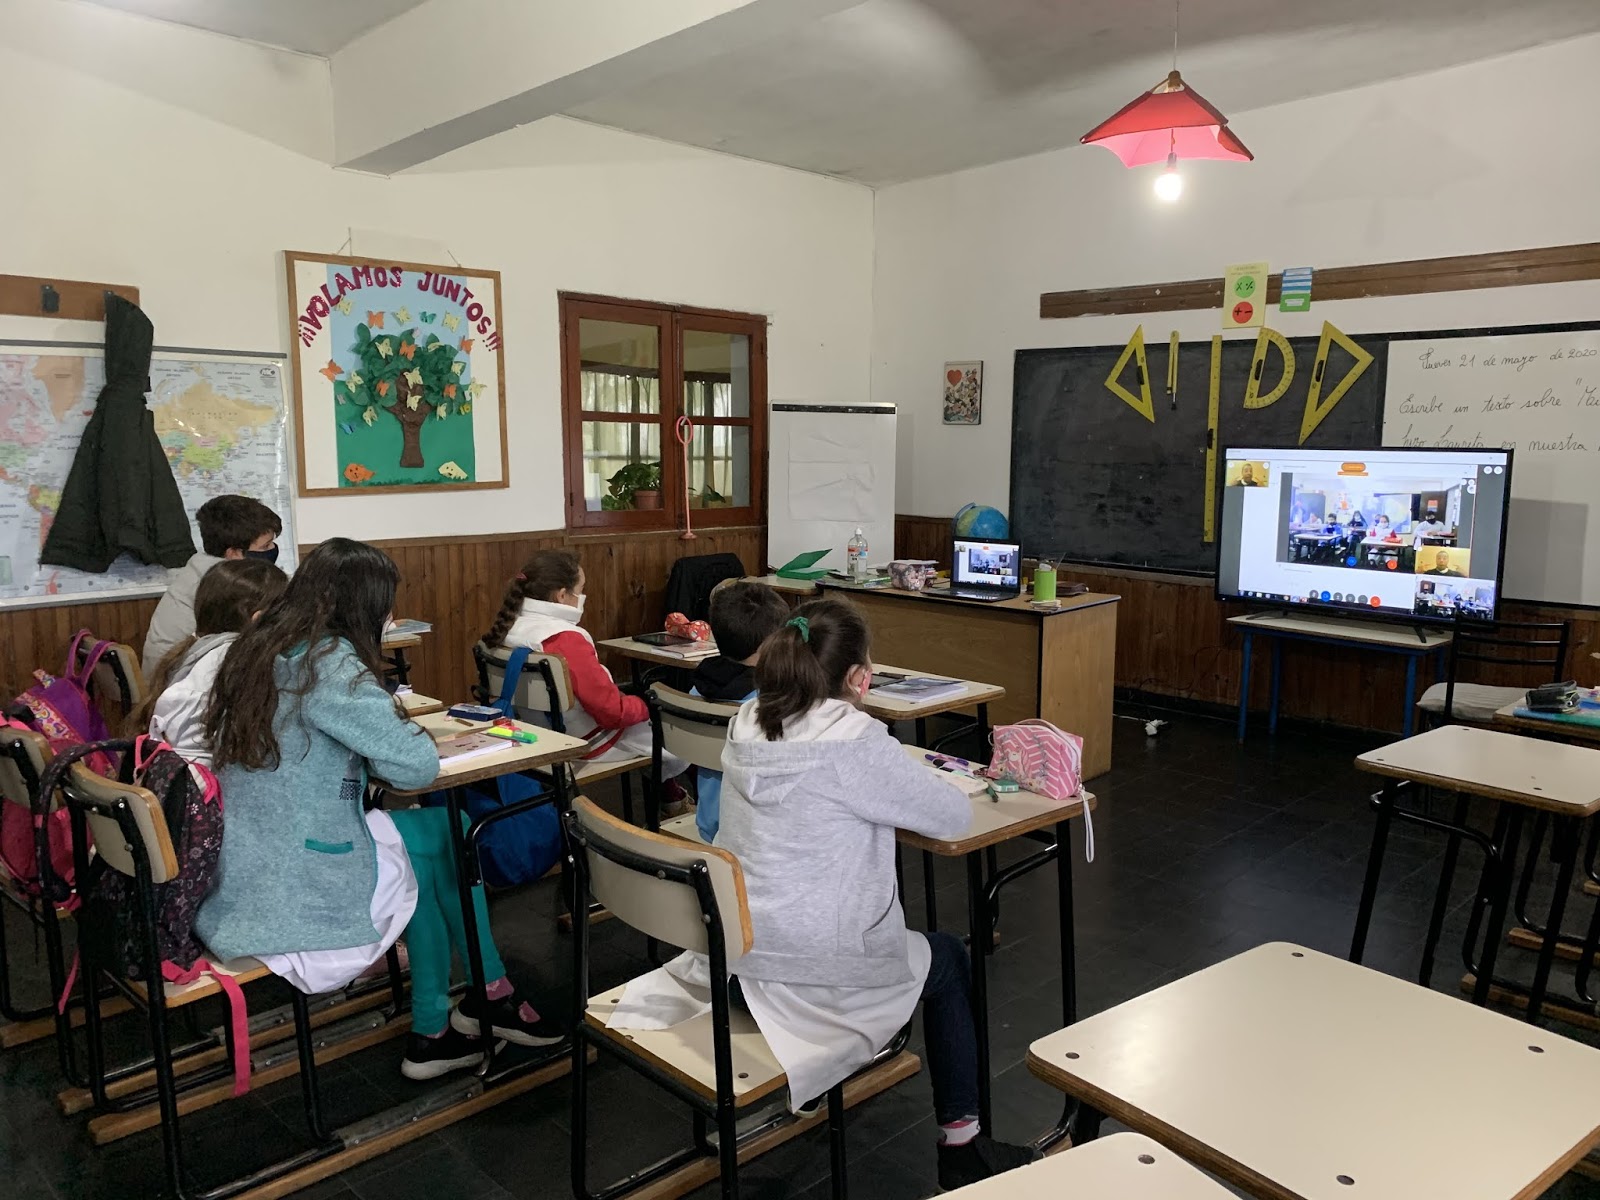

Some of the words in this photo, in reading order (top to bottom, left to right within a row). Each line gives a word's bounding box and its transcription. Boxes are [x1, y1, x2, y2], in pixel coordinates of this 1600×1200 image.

[1459, 354, 1475, 368] 21
[1483, 354, 1497, 367] de
[1501, 354, 1538, 372] mayo
[1549, 348, 1564, 361] de
[1567, 348, 1598, 360] 2020
[1399, 393, 1443, 414] Escribe
[1453, 404, 1470, 414] un
[1480, 394, 1514, 414] texto
[1519, 387, 1563, 409] sobre
[1528, 432, 1589, 452] nuestra
